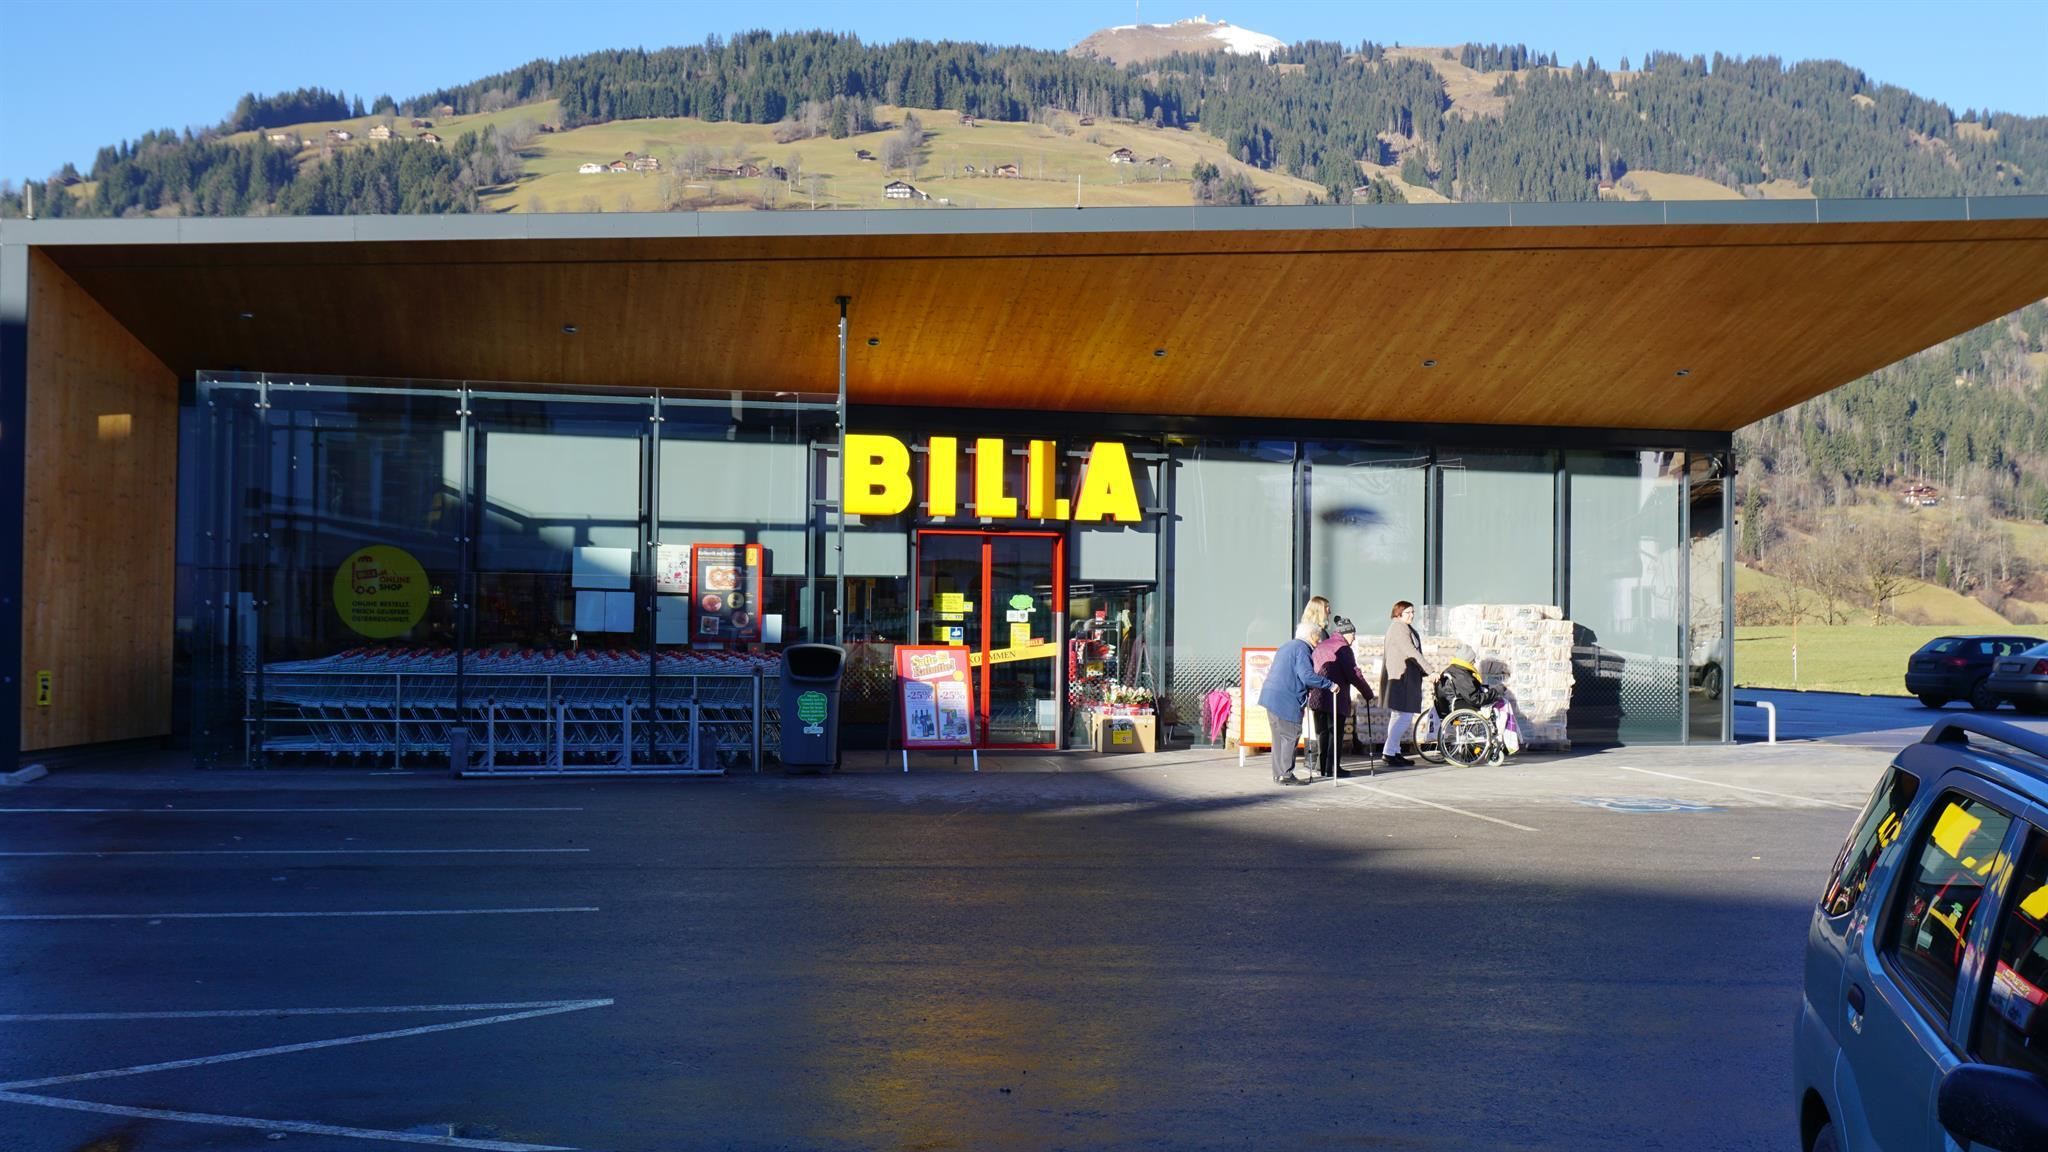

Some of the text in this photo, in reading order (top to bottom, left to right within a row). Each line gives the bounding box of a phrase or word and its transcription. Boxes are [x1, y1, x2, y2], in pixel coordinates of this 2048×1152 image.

[843, 434, 1142, 522] BILLA
[379, 576, 411, 584] ONLINE
[907, 690, 934, 701] -25%
[940, 690, 966, 701] -25%
